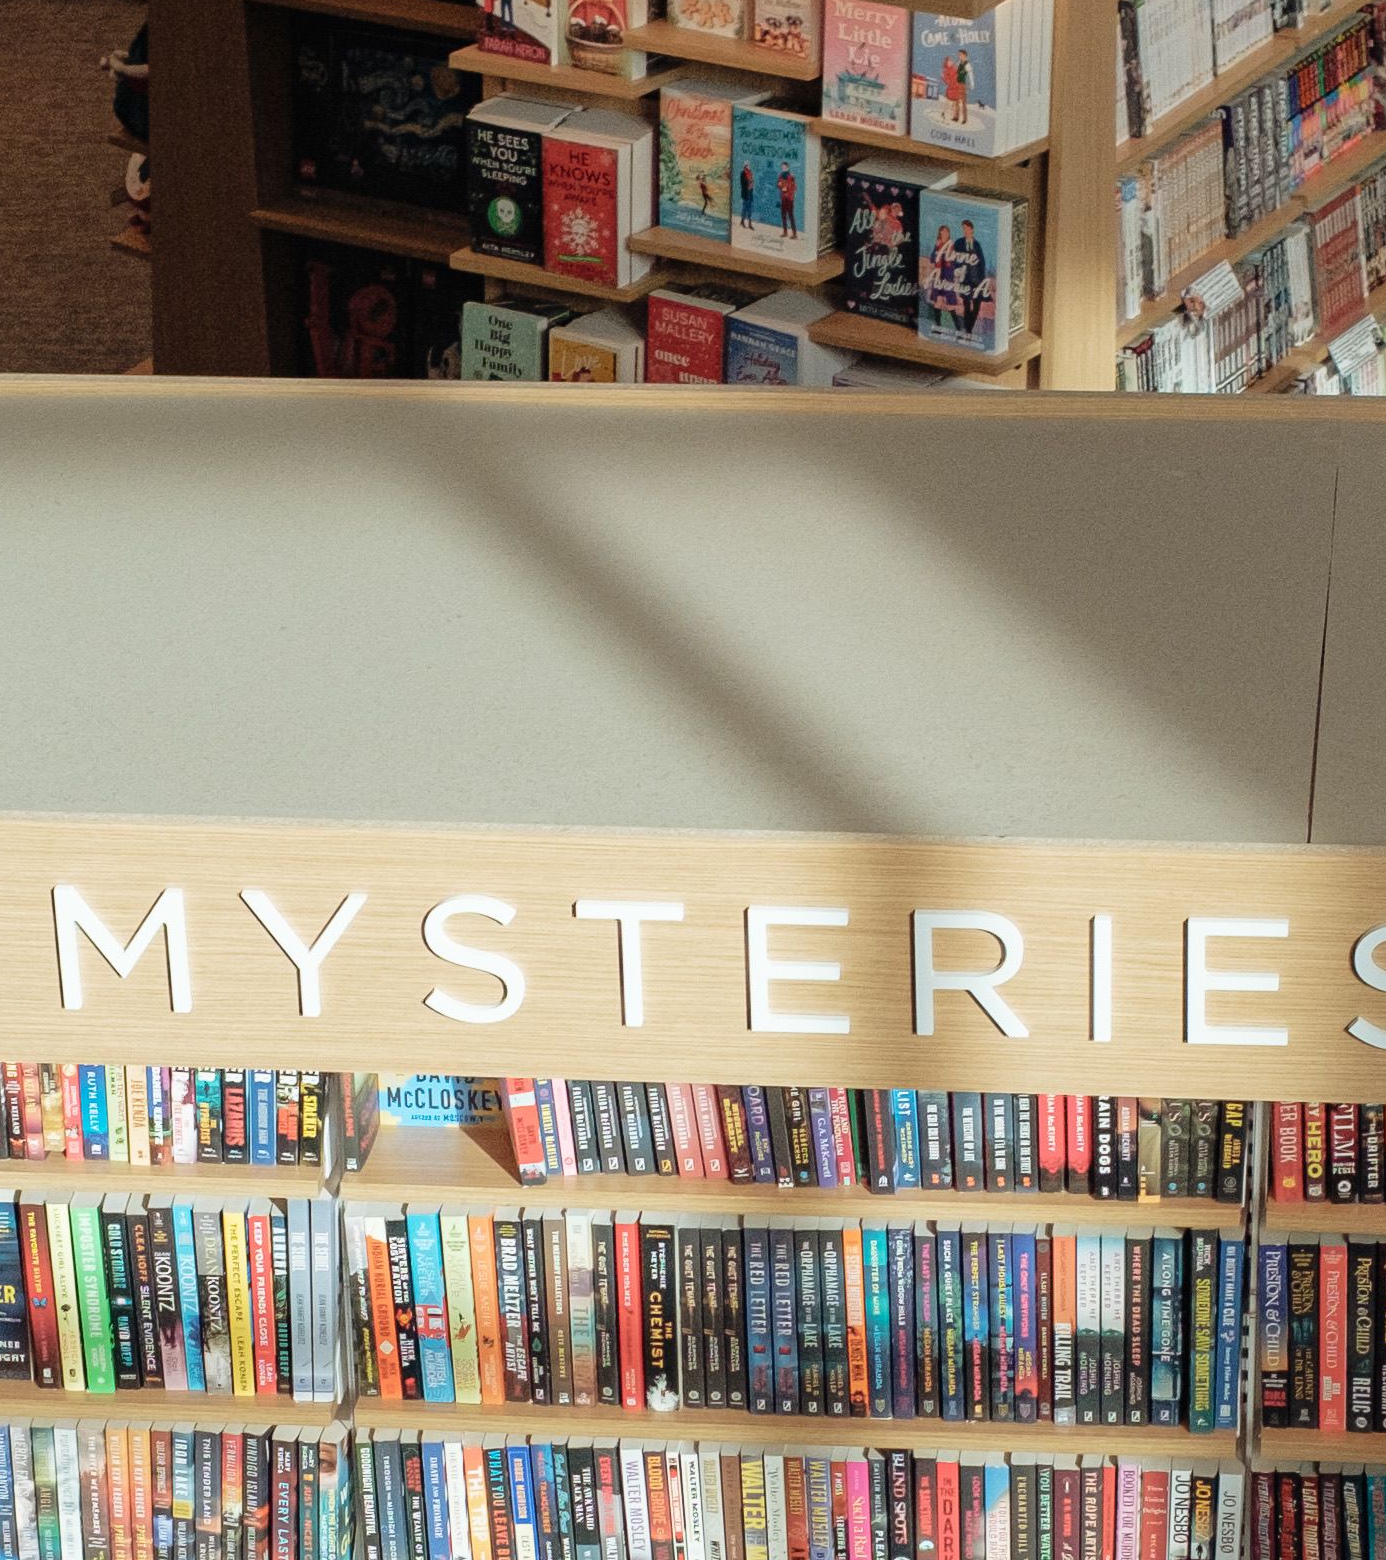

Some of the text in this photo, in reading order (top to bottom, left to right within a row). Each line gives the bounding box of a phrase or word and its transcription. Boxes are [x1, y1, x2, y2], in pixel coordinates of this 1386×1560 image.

[832, 0, 898, 30] Merry
[837, 22, 893, 50] Little
[847, 41, 881, 68] Lie
[477, 128, 530, 151] HE SEES
[488, 143, 519, 163] YOU
[568, 149, 591, 166] HE
[547, 164, 612, 187] KNOWS
[154, 1255, 176, 1314] KOONTZ
[649, 1290, 665, 1370] CHEMIST
[740, 1460, 766, 1530] WALTER
